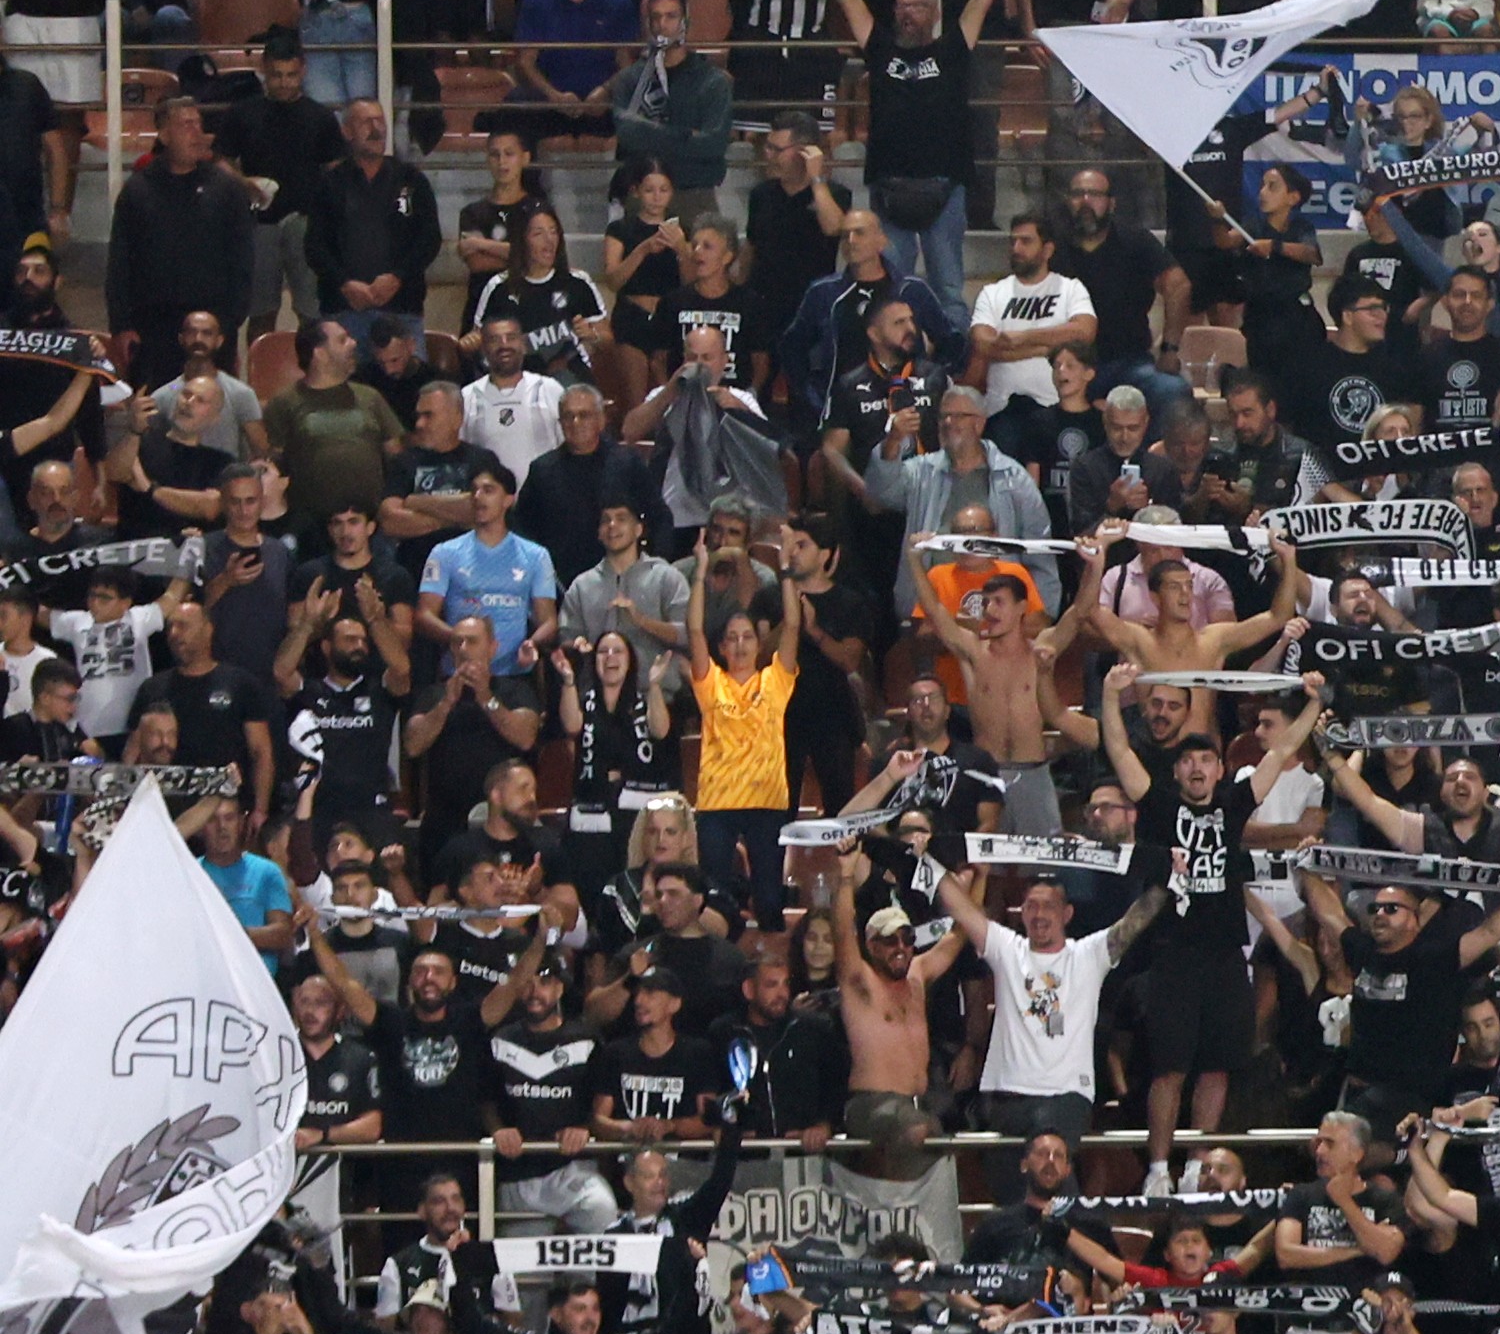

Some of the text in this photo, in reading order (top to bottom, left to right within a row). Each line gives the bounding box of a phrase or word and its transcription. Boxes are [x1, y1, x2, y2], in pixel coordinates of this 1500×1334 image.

[1002, 294, 1060, 321] NIKE
[1338, 442, 1384, 465] OFI
[1396, 434, 1489, 456] CRETE
[59, 539, 167, 574] CRETE
[1316, 636, 1381, 662] OFI
[311, 712, 373, 728] betsson
[535, 1237, 617, 1267] 1925
